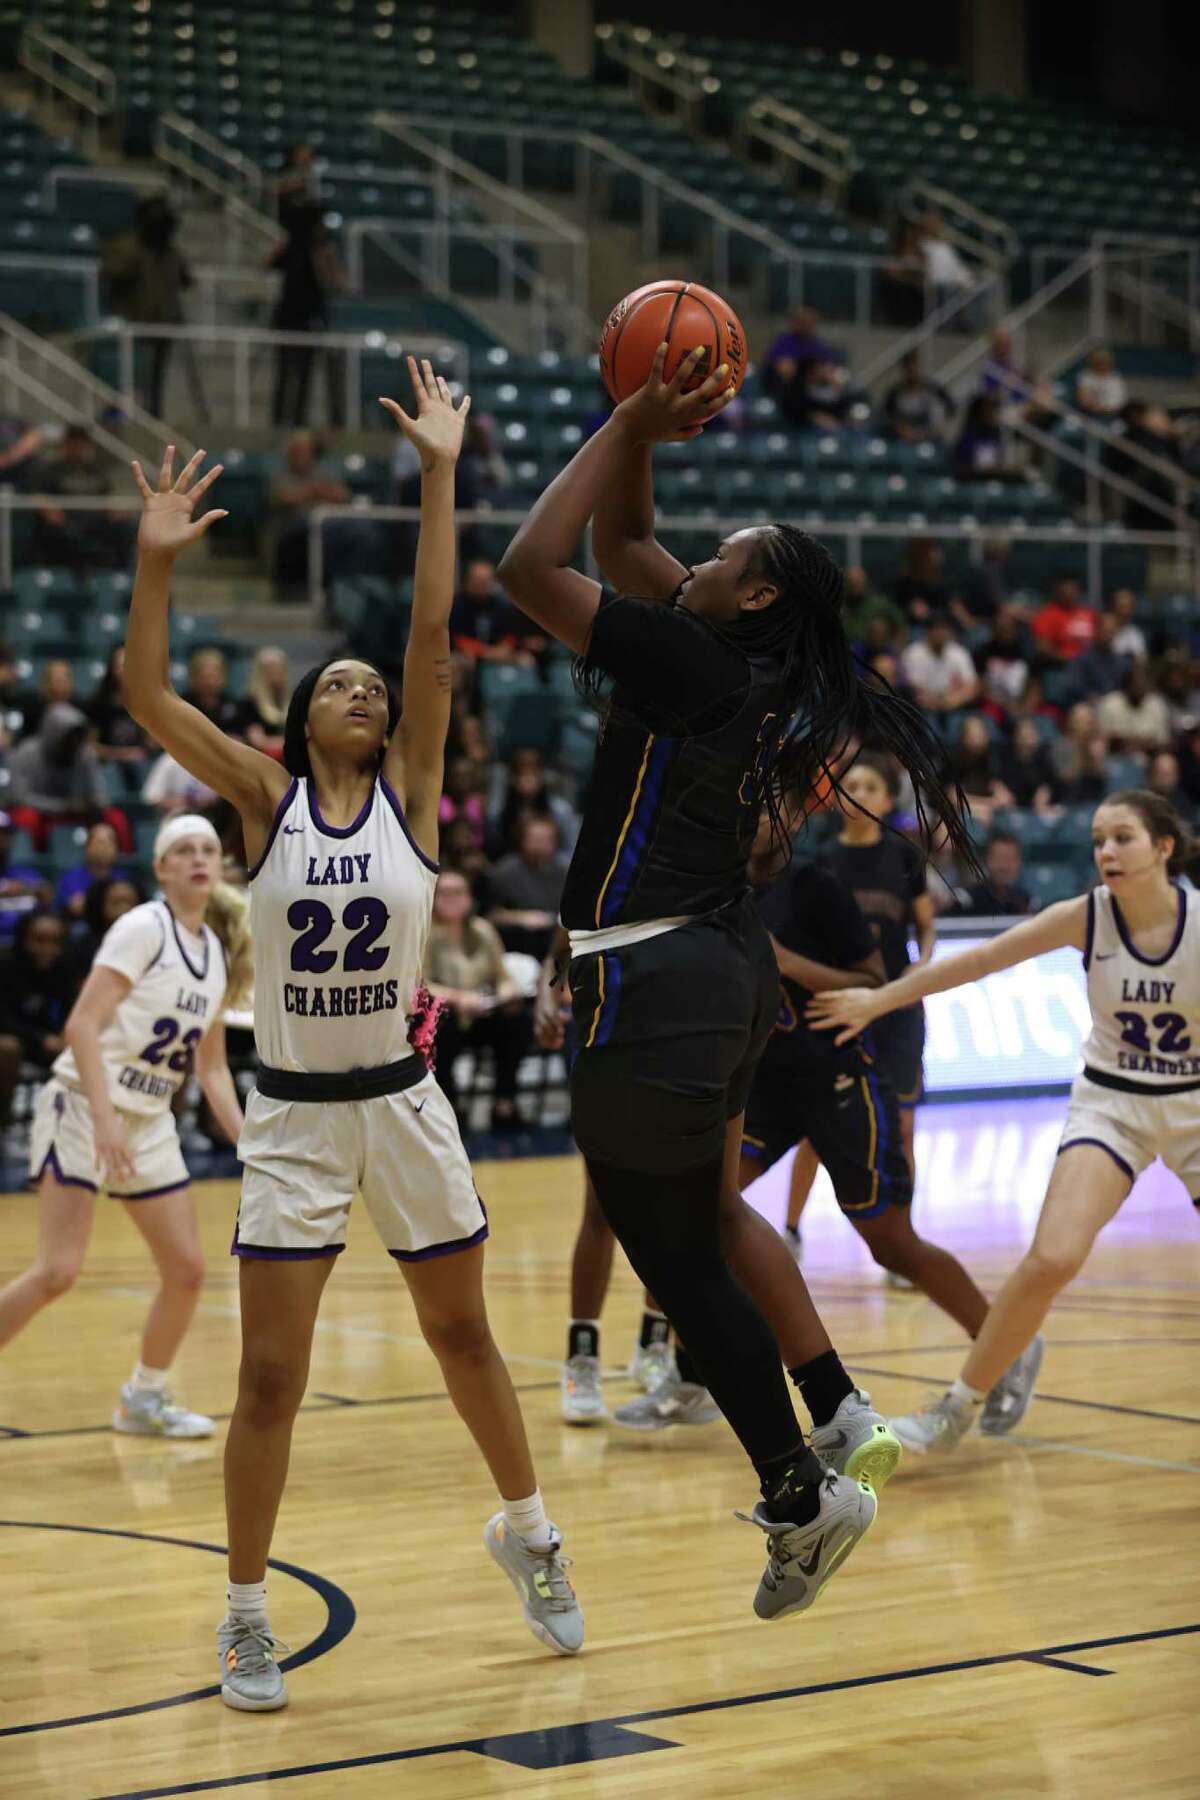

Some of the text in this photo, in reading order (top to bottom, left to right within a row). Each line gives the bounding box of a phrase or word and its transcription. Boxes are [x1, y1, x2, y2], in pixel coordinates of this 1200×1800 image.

[306, 853, 371, 886] LADY
[287, 896, 390, 973] 22
[284, 980, 398, 1017] CHARGERS
[1121, 979, 1175, 1004] LADY
